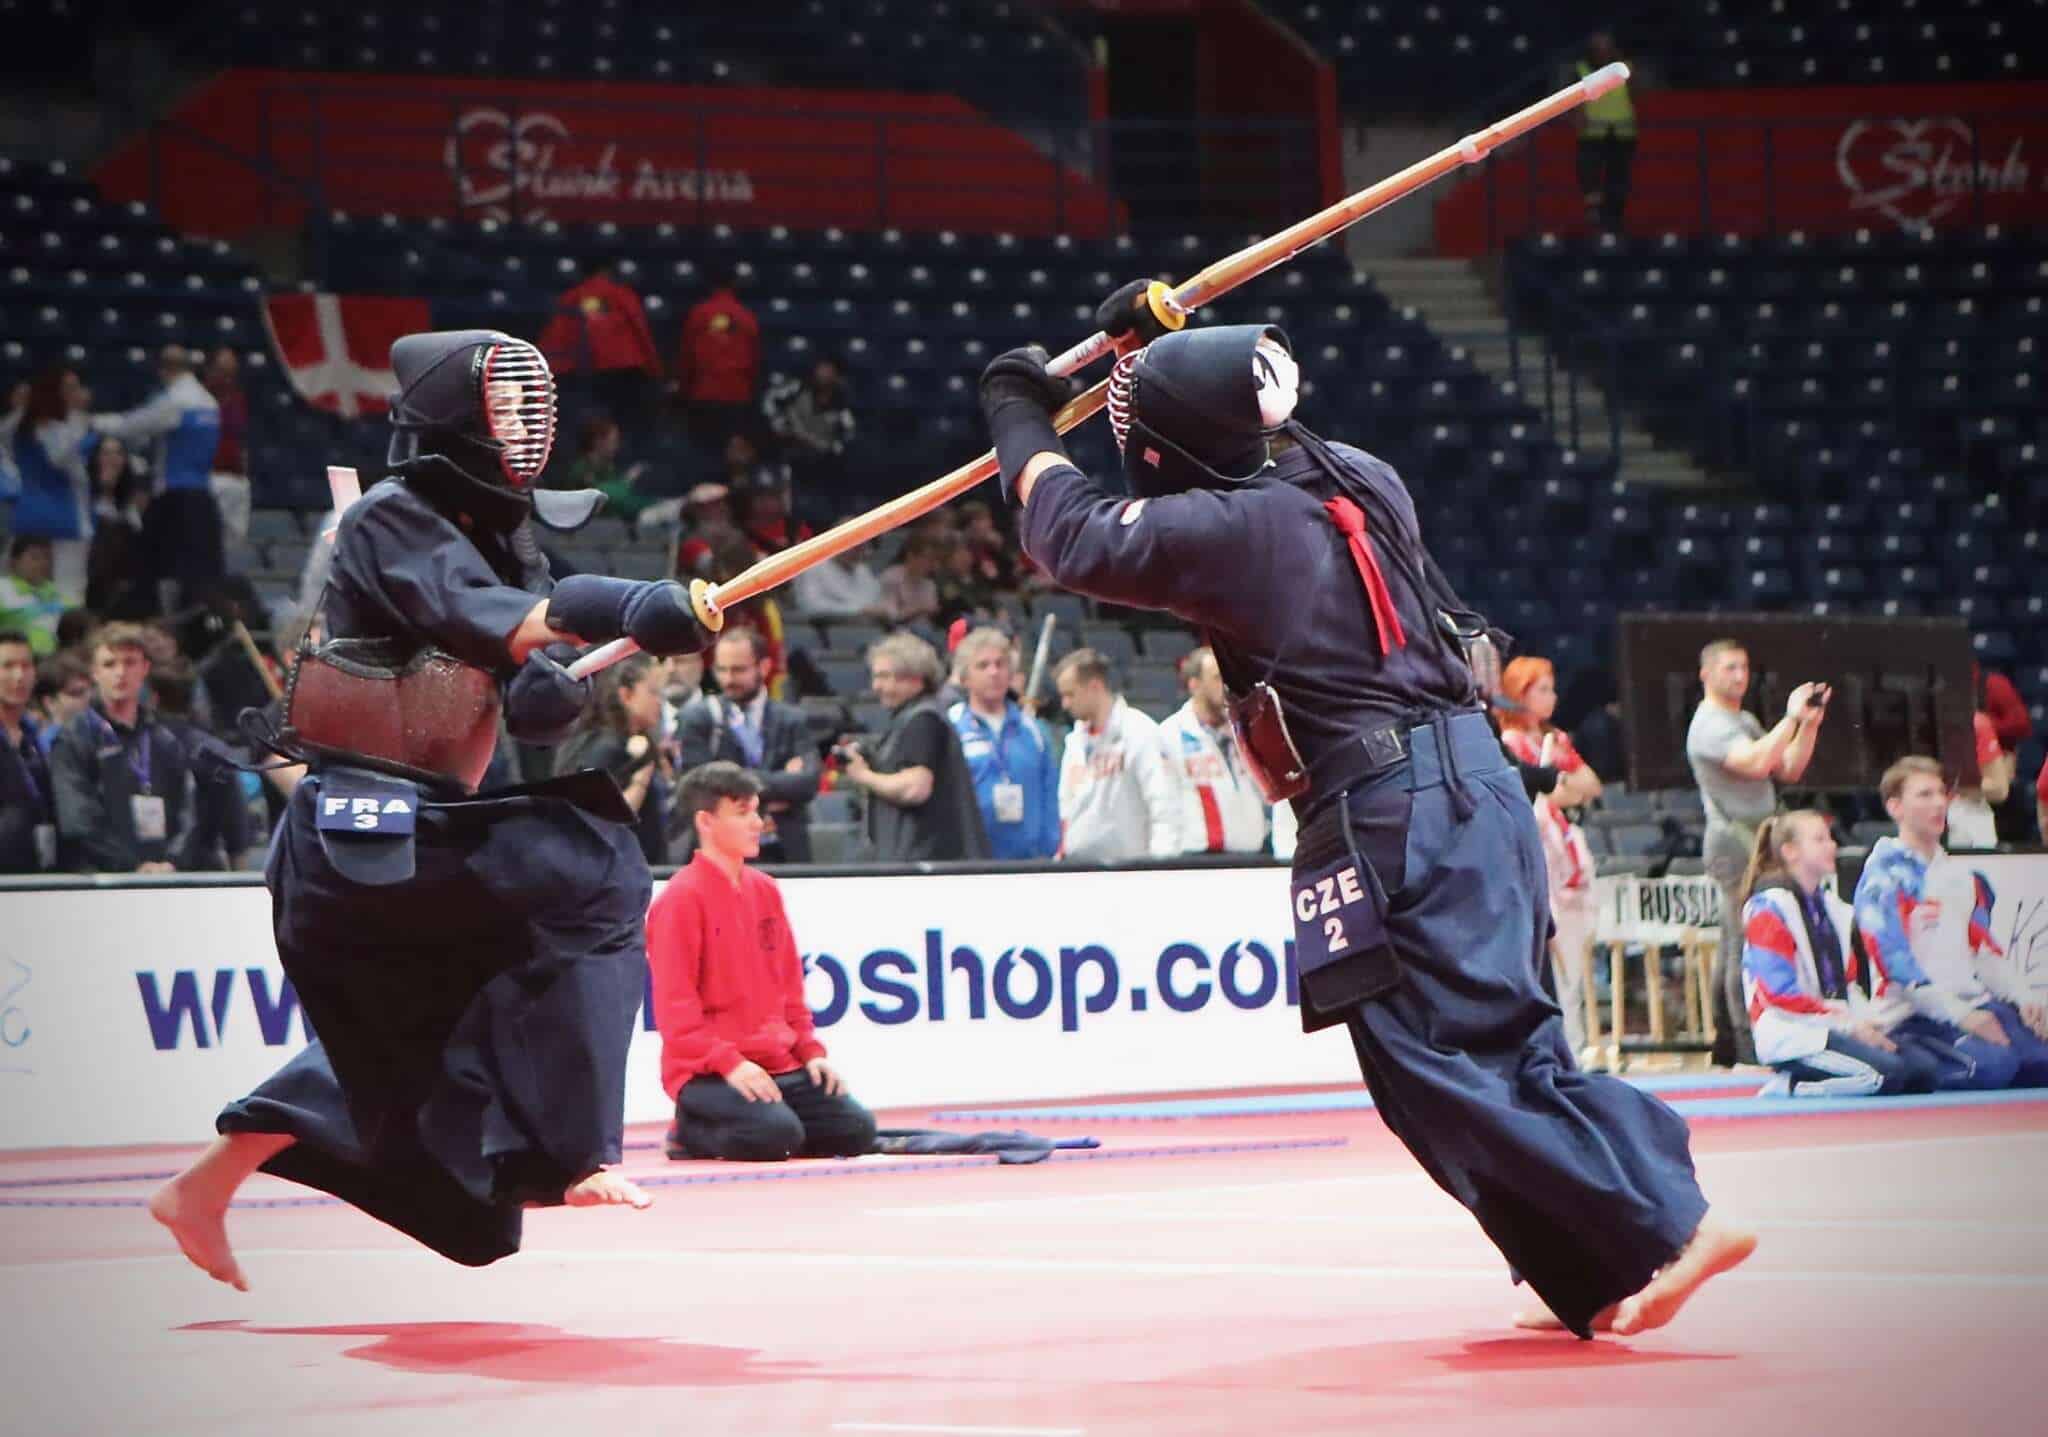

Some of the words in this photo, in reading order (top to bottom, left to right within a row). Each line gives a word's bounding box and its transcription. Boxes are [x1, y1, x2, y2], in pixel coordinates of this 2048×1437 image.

[325, 798, 411, 815] FRA
[353, 814, 379, 829] 3
[1296, 867, 1364, 922] CZE
[1324, 918, 1349, 952] 2
[801, 929, 1299, 1032] oshop.co
